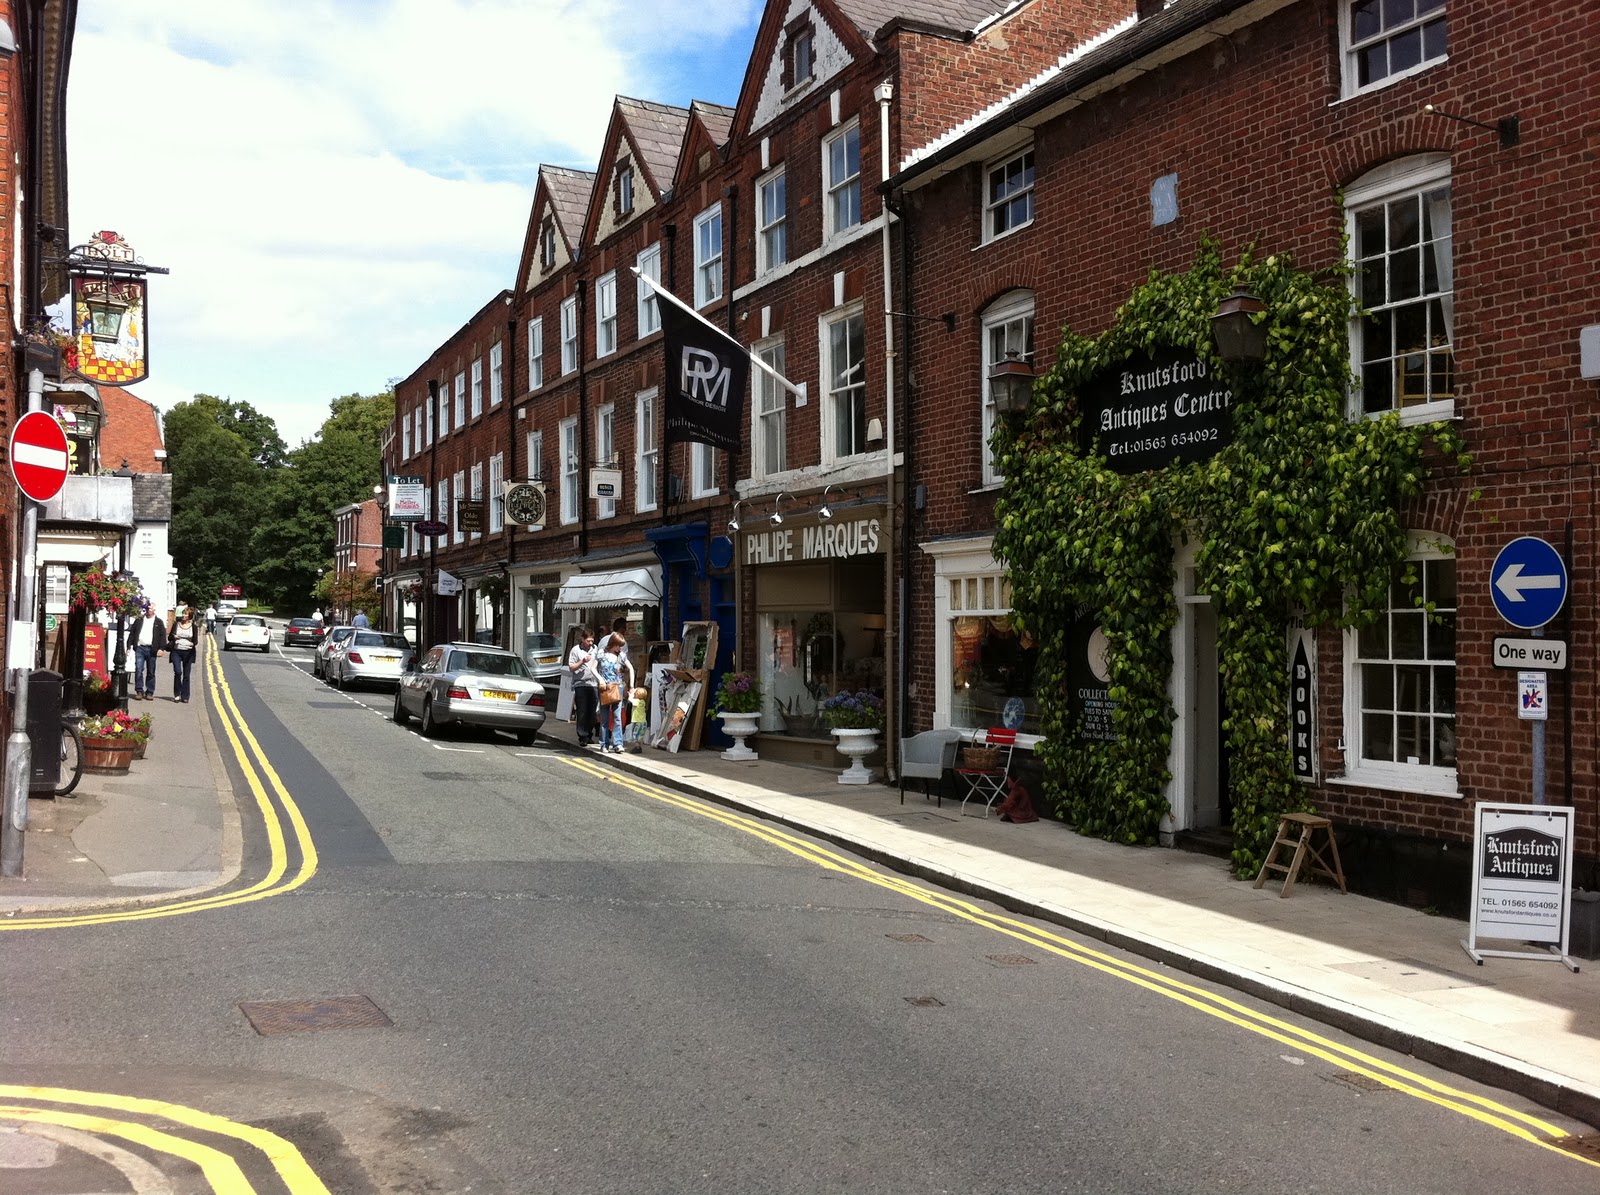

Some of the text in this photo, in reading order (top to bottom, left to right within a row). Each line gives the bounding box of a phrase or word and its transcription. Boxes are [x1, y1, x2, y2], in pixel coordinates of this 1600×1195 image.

[88, 247, 131, 258] HOLT
[1120, 357, 1206, 395] Knutsford
[680, 390, 727, 413] INTERIOR DESIGN
[1100, 389, 1233, 433] Antiques Centre
[1171, 428, 1218, 447] 654092
[393, 476, 420, 484] To Let
[747, 519, 879, 564] PHILIPE MARQUES
[1499, 644, 1560, 663] One way
[1296, 664, 1308, 771] BOOKS
[1487, 836, 1559, 857] Knutsford
[1491, 855, 1553, 878] Antiques
[1501, 898, 1527, 908] 01565
[1528, 900, 1558, 910] 654092
